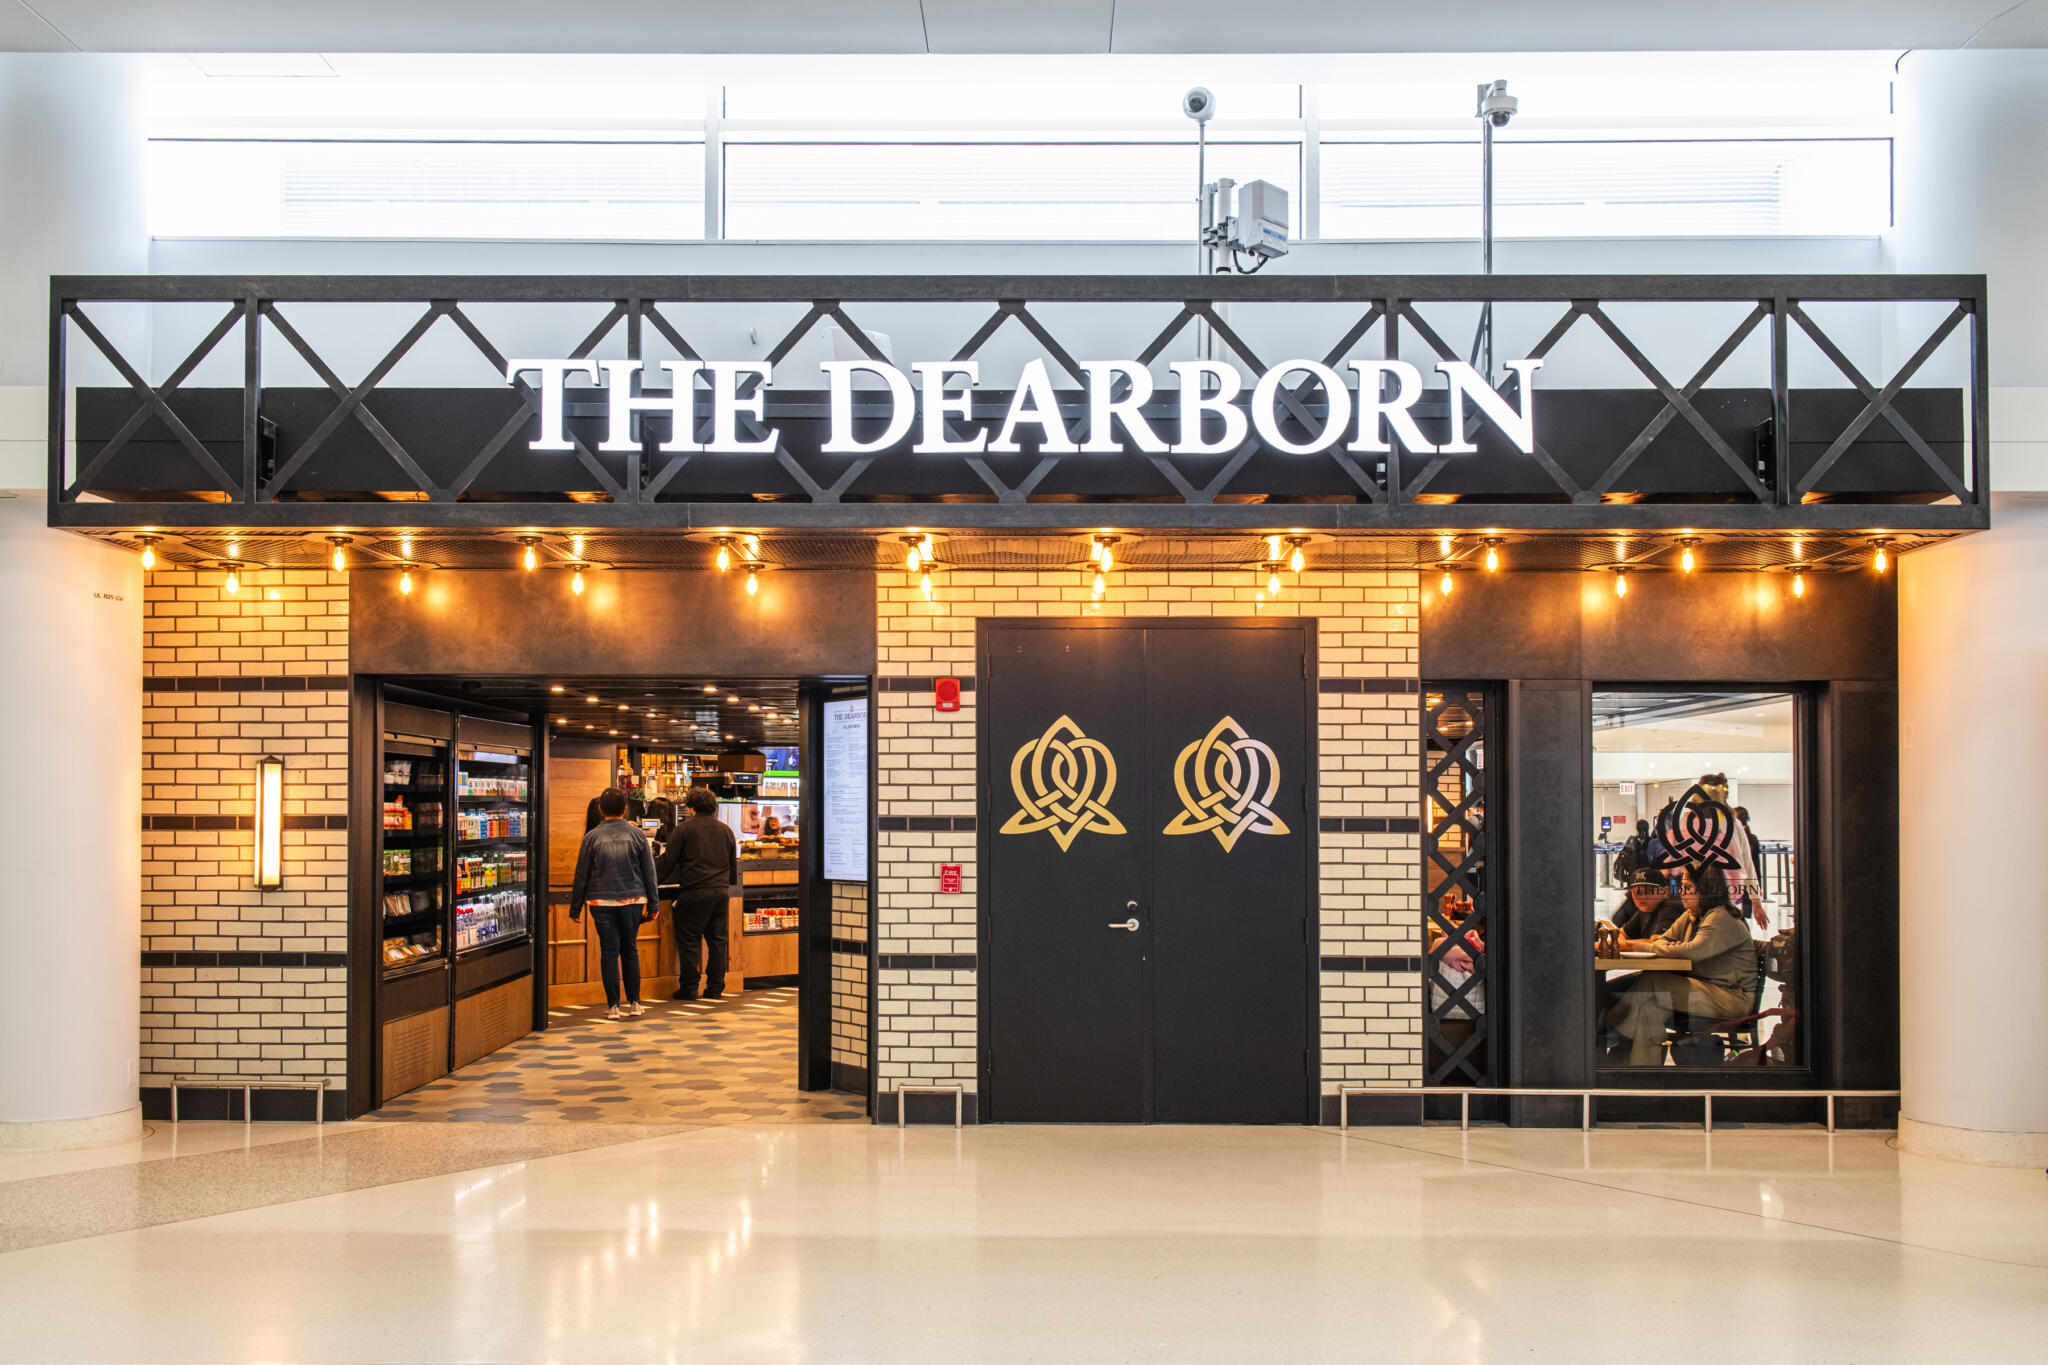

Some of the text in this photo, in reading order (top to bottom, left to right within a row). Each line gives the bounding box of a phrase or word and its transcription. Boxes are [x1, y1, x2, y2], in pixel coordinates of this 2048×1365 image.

[506, 358, 1545, 455] THE DEARBORN
[1620, 784, 1633, 792] EXIT
[1636, 884, 1665, 896] THE
